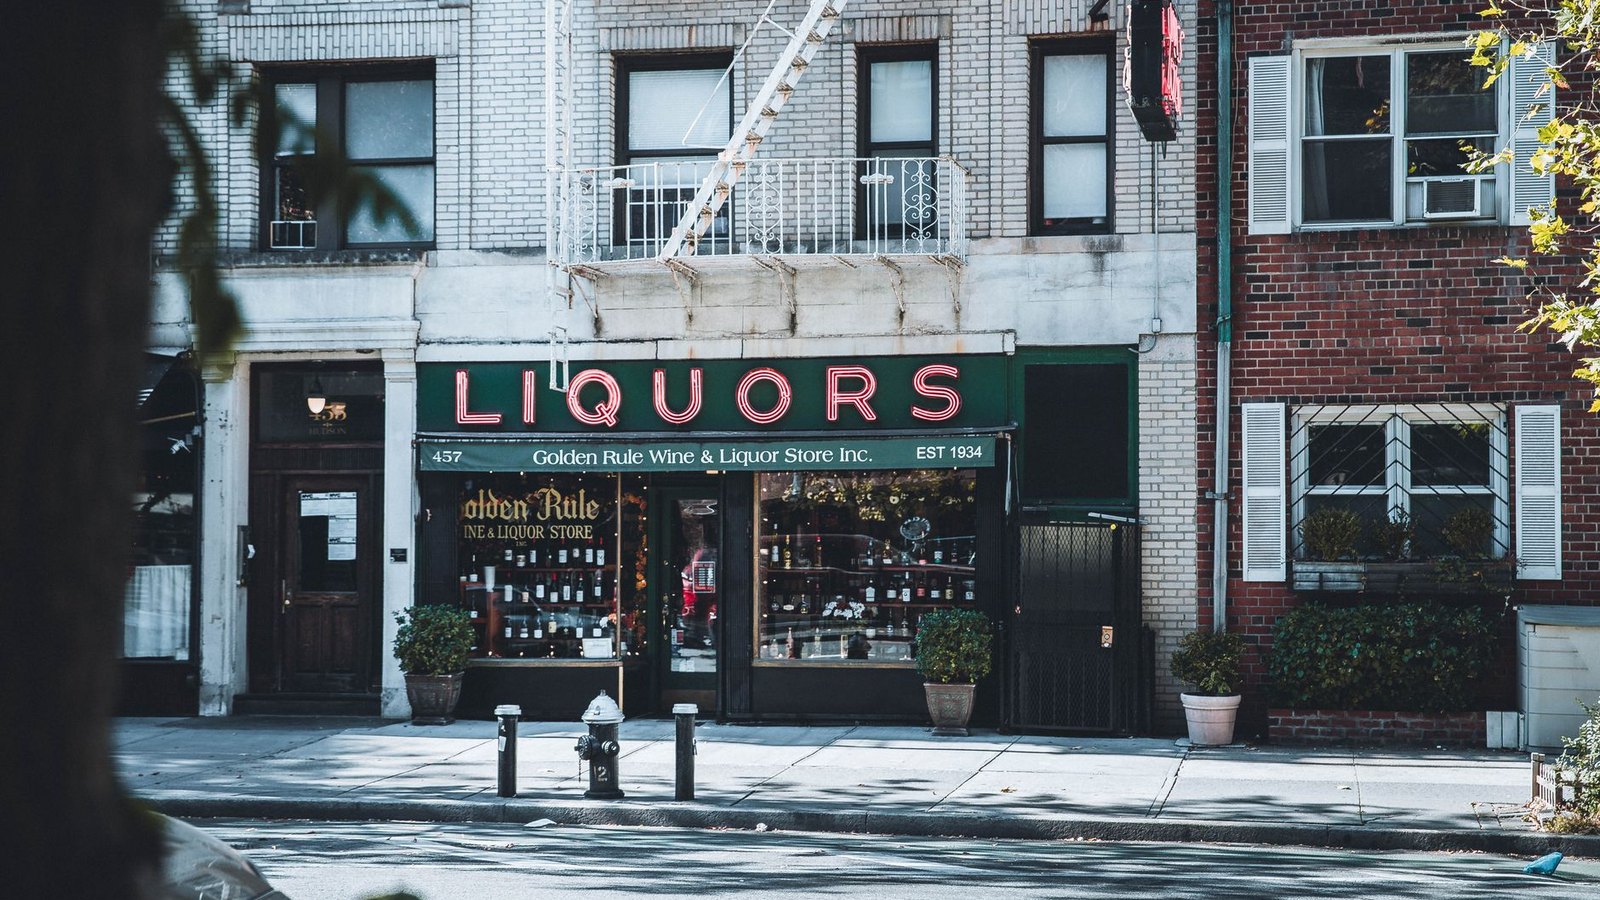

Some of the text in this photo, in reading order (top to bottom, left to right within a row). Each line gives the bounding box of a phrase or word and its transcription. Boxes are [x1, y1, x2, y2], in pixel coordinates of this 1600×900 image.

[455, 364, 963, 427] LIQUORS
[432, 450, 463, 463] 457
[532, 447, 873, 467] Golden Rule Wine & Liquor Store Inc.
[916, 445, 983, 460] EST 1934
[464, 487, 600, 522] olden Rule
[464, 525, 593, 541] INE & LIQUOR STORE
